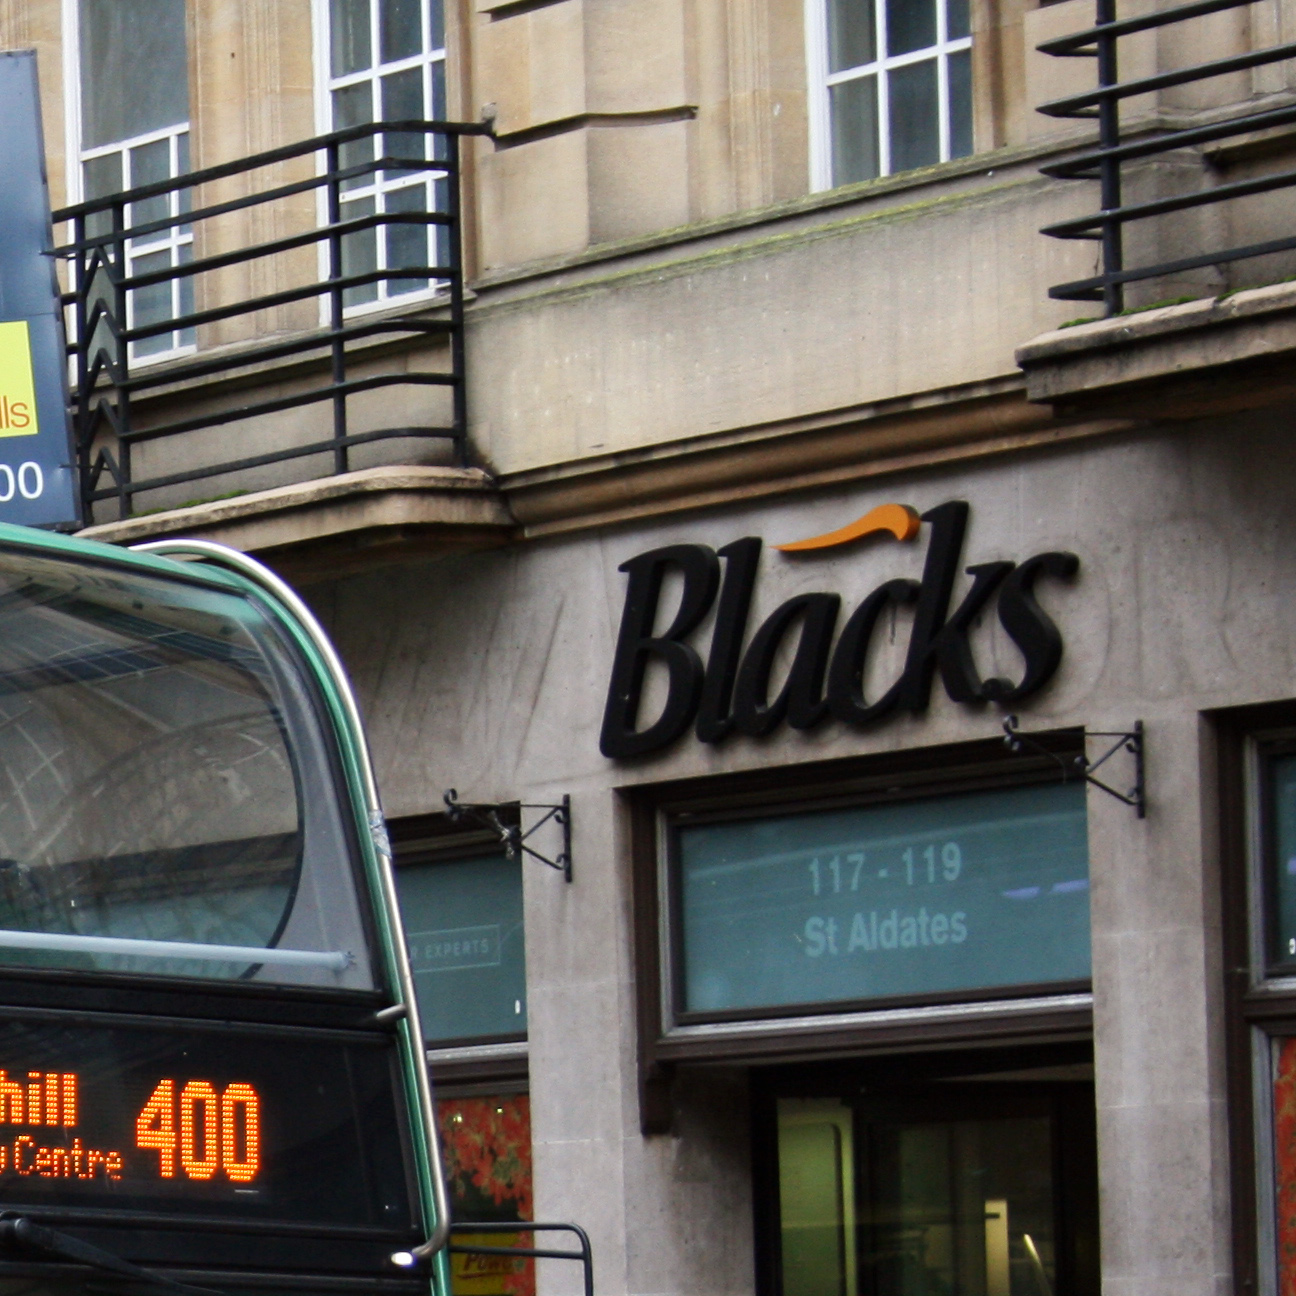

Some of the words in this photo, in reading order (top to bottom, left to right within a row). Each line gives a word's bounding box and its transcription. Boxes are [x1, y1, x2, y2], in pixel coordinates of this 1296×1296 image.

[599, 500, 1081, 760] Blacks
[809, 853, 864, 896] 117
[904, 842, 961, 886] 119
[804, 915, 838, 957] St
[847, 907, 968, 951] Aldates
[135, 1078, 261, 1181] 400
[14, 1134, 124, 1180] Centre
